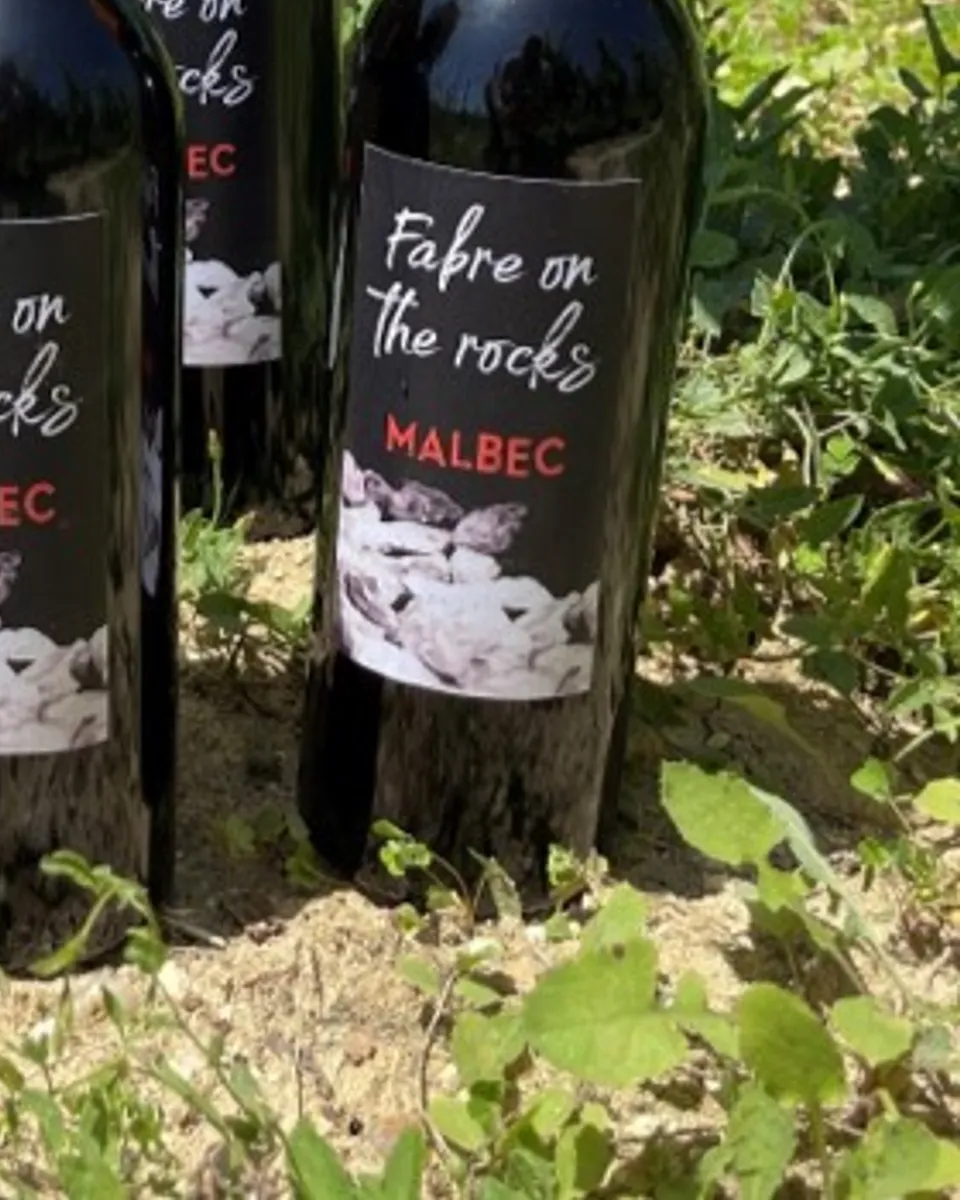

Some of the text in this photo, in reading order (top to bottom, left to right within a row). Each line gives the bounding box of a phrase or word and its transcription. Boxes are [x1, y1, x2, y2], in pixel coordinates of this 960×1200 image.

[175, 27, 258, 107] cks
[386, 203, 598, 291] Fabre on
[12, 293, 70, 335] on
[366, 281, 599, 393] the rocks
[385, 413, 566, 476] MALBEC
